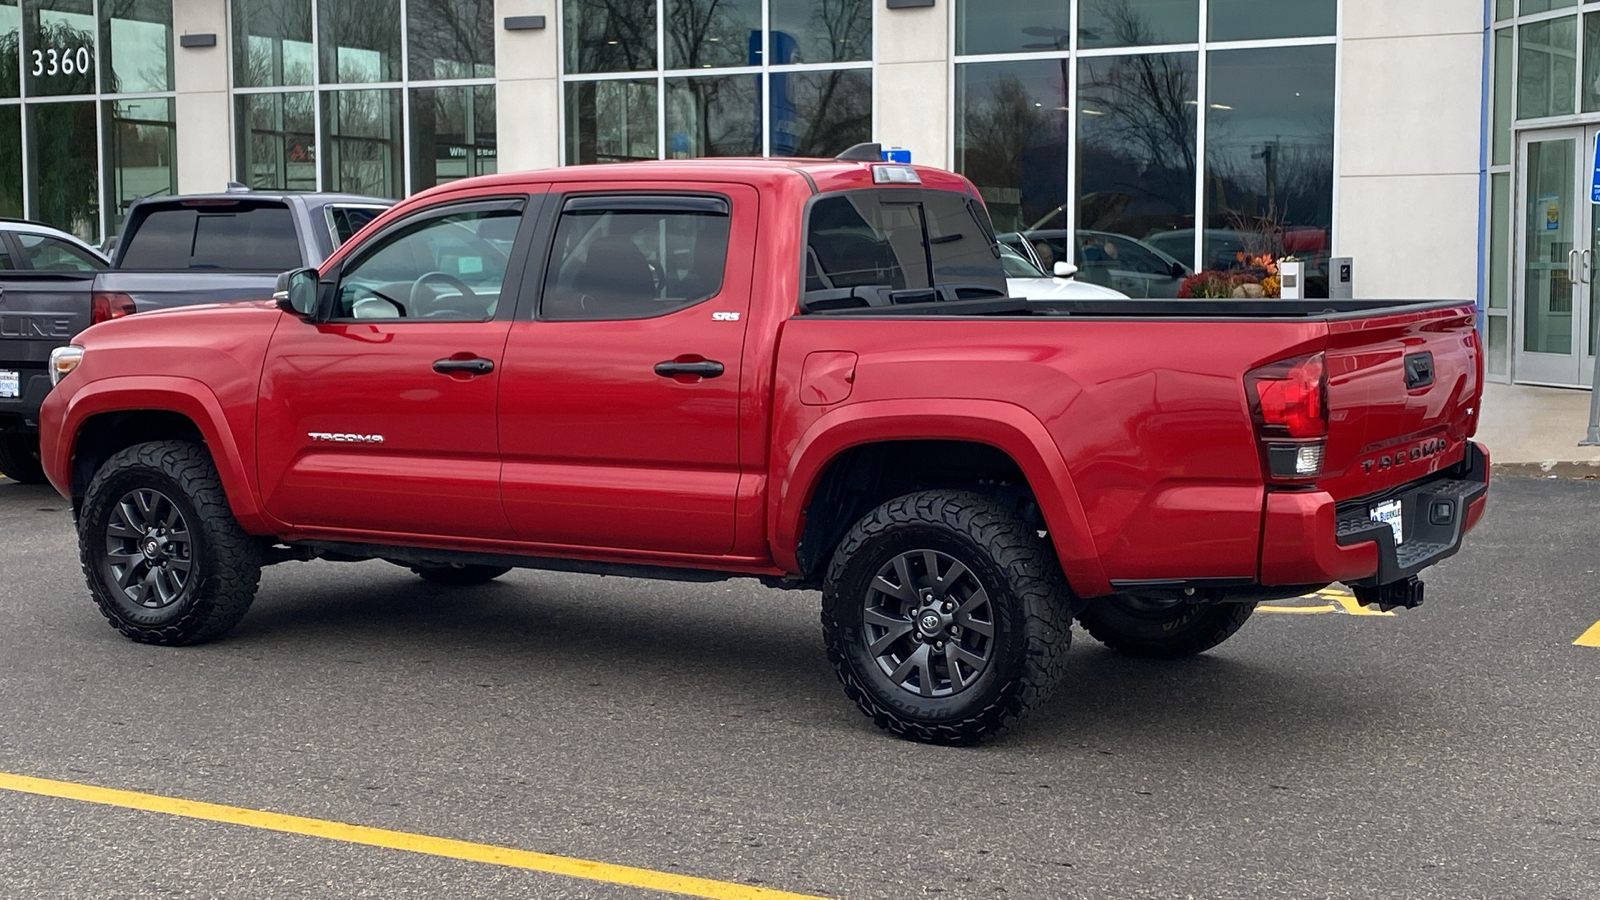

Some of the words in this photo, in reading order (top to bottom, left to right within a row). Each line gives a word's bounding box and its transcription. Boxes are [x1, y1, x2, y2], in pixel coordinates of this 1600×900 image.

[32, 46, 89, 76] 3360
[0, 316, 70, 337] LINE
[711, 311, 740, 321] SR5
[308, 432, 384, 444] TACOMA
[1360, 438, 1446, 475] TACOMA
